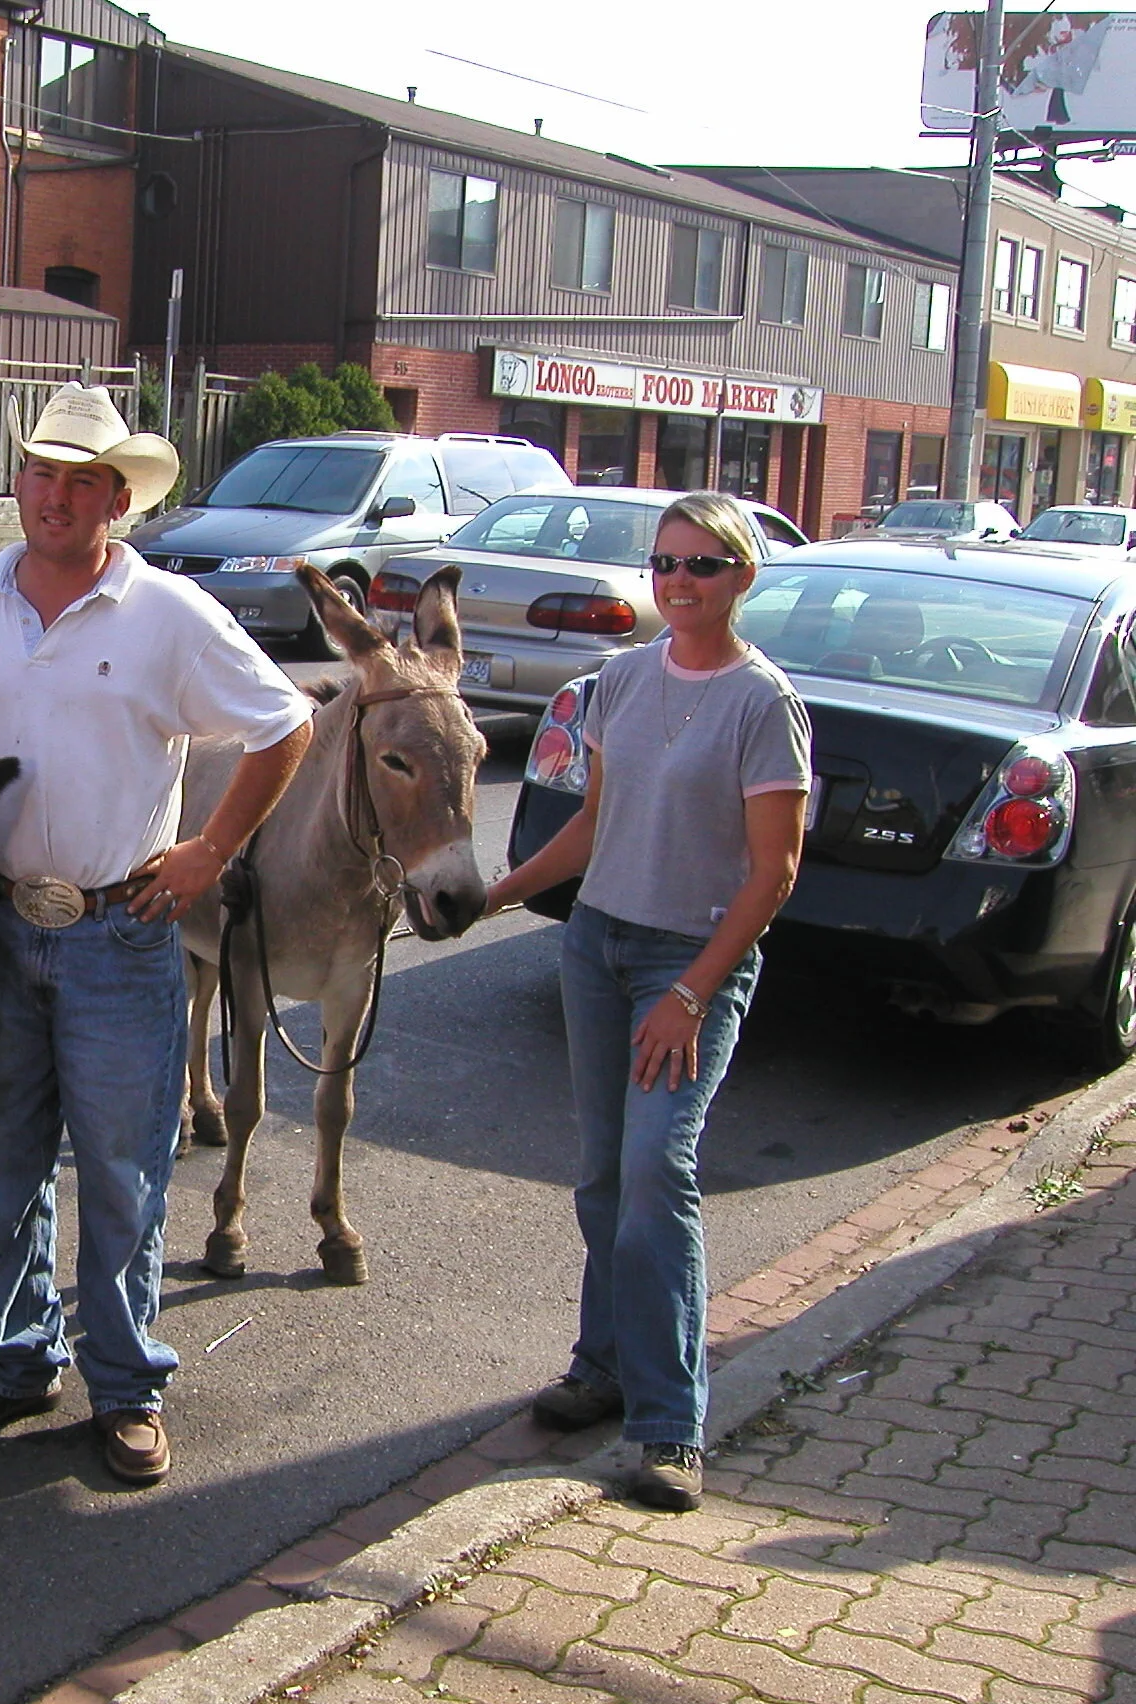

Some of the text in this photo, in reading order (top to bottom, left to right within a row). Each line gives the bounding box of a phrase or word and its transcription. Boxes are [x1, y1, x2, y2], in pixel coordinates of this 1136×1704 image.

[536, 360, 595, 397] LONGO
[596, 384, 633, 400] BROTHERS
[642, 374, 693, 406] FOOD
[466, 660, 487, 677] 636
